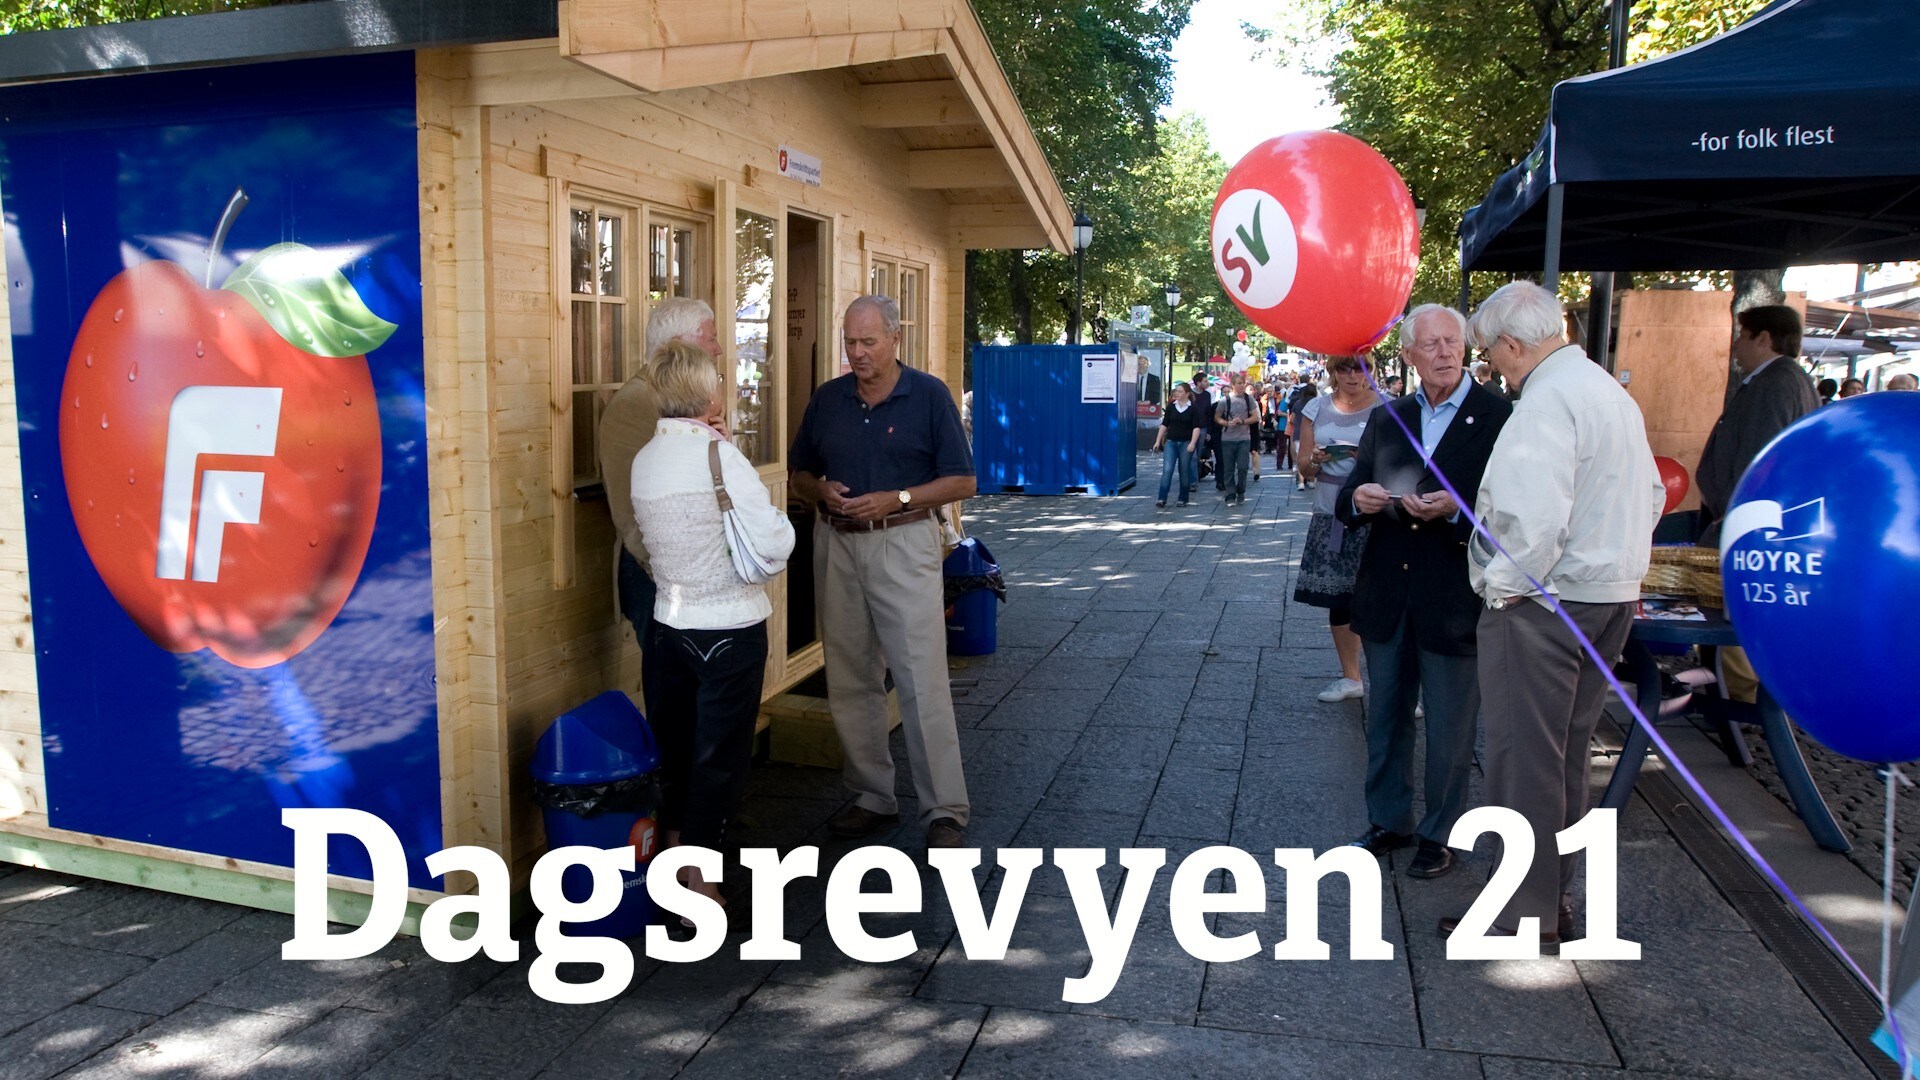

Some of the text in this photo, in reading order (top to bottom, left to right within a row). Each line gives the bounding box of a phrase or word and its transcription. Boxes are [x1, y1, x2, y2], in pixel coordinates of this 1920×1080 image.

[1691, 125, 1835, 152] -for folk flest
[1221, 198, 1270, 294] SV
[1733, 549, 1823, 576] HØYRE
[1741, 582, 1811, 606] 125 år
